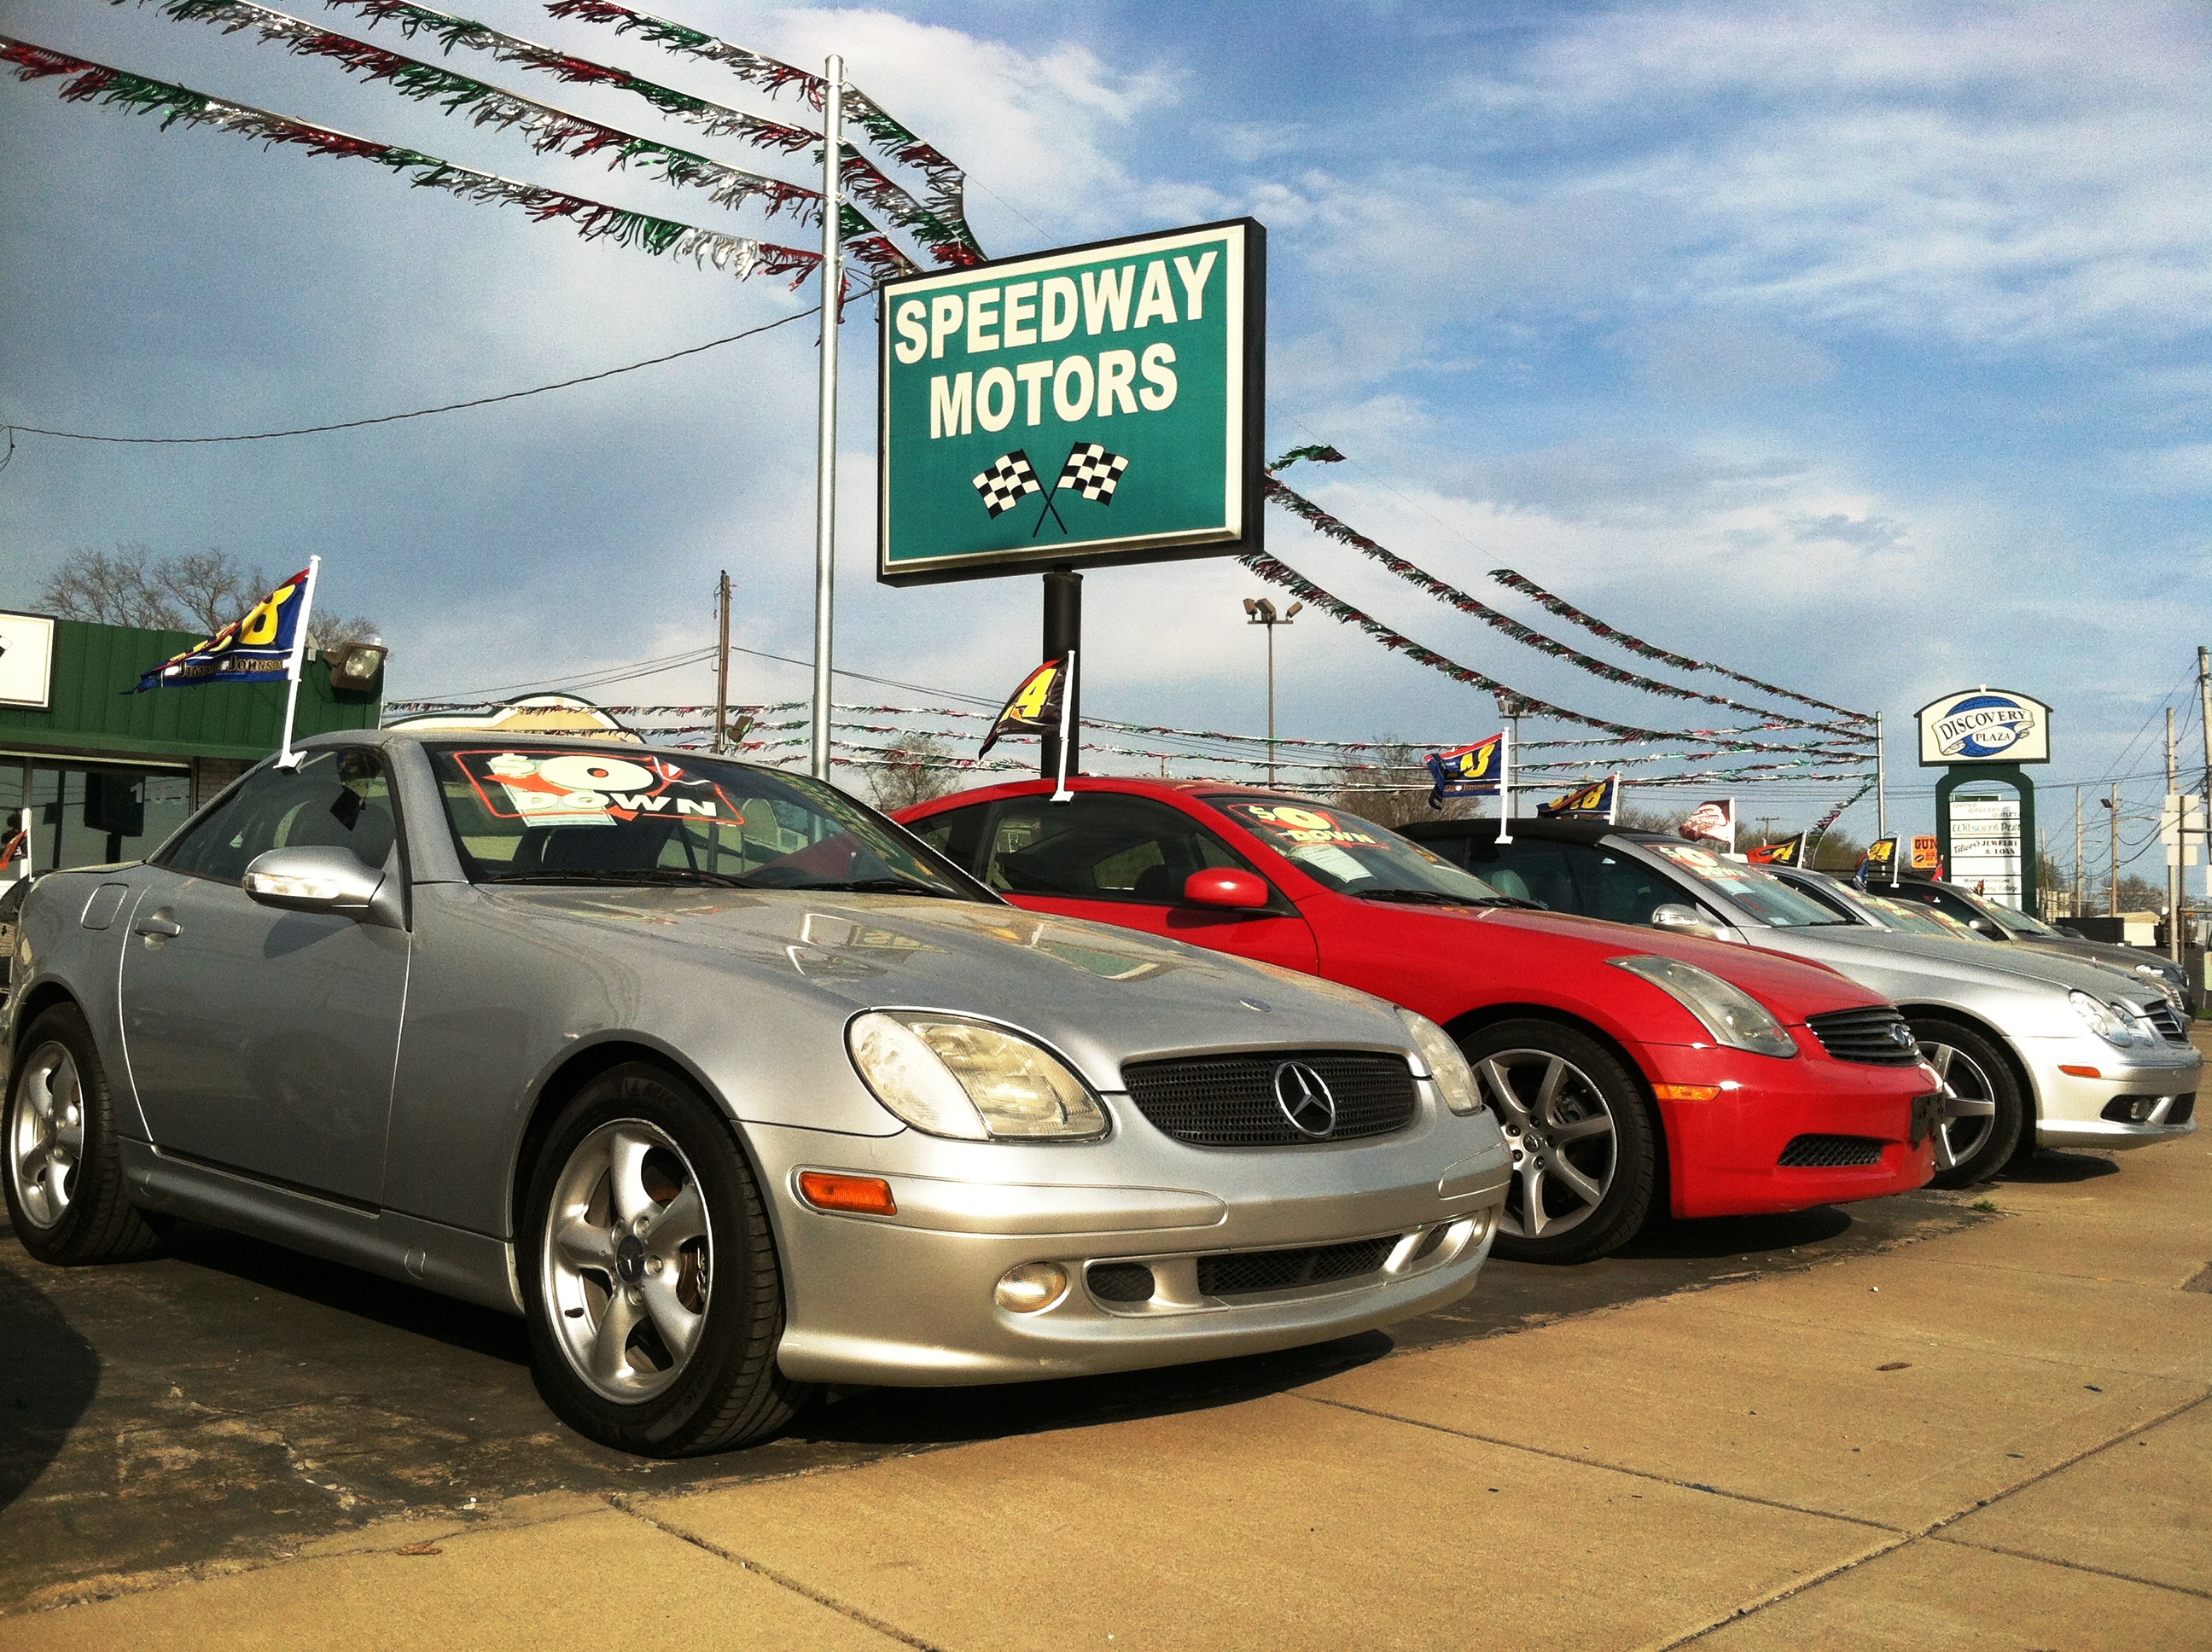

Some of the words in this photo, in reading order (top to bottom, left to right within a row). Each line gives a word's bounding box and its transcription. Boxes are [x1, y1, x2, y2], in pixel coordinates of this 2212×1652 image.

[894, 250, 1218, 364] SPEEDWAY
[929, 342, 1178, 439] MOTORS
[1939, 711, 2026, 740] DISCOVERY
[1976, 733, 2011, 742] PLAZA
[515, 791, 717, 817] DOWN
[1287, 829, 1376, 844] DOWN
